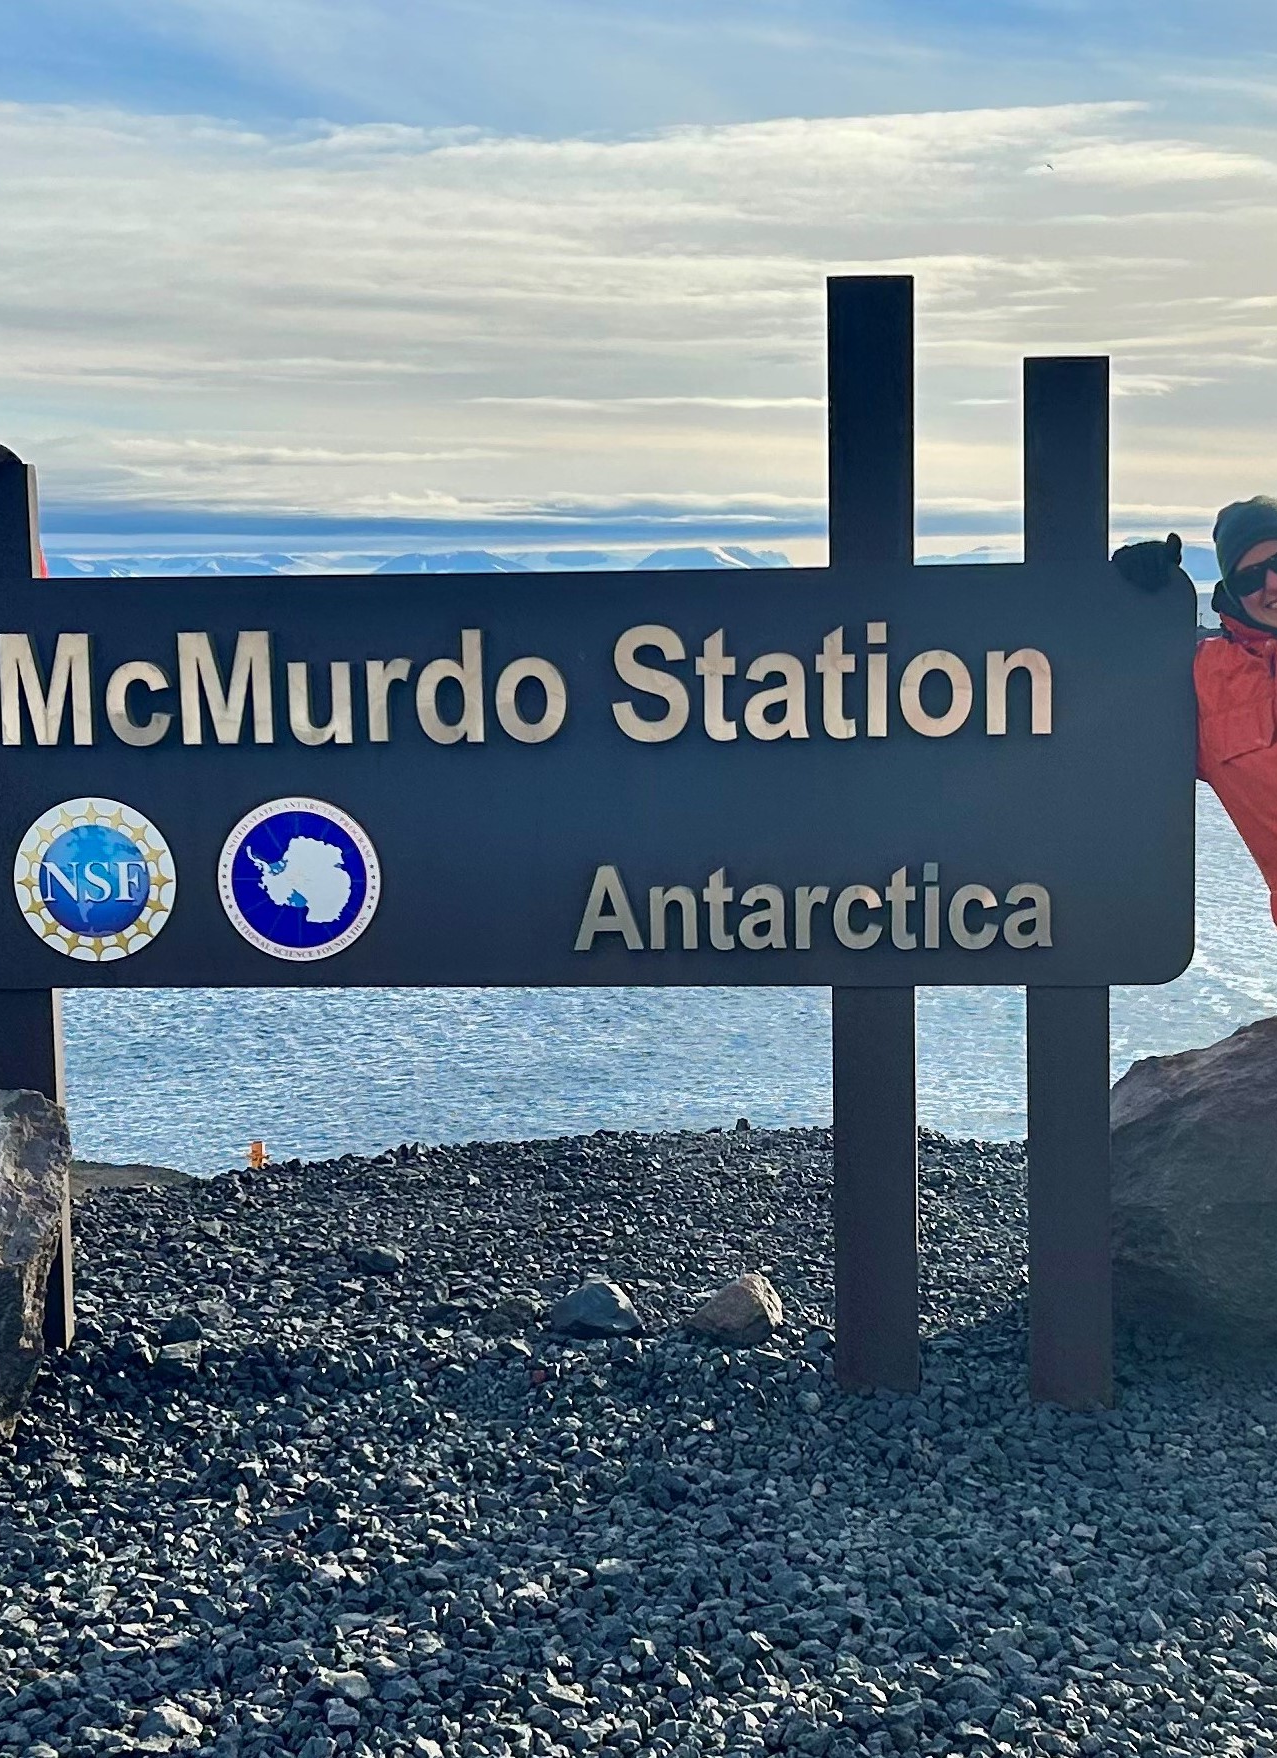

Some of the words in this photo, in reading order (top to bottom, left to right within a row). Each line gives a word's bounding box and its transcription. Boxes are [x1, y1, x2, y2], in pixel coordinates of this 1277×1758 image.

[0, 630, 566, 746] McMurdo
[613, 623, 1051, 742] Station
[284, 801, 339, 818] ANTARCTIC
[339, 816, 372, 858] PROGRAM
[40, 860, 148, 902] NSF
[575, 866, 1052, 950] Antarctica
[234, 914, 272, 951] NATIONAL
[272, 946, 314, 958] SCIENCE
[316, 916, 368, 956] FOUNDATION
